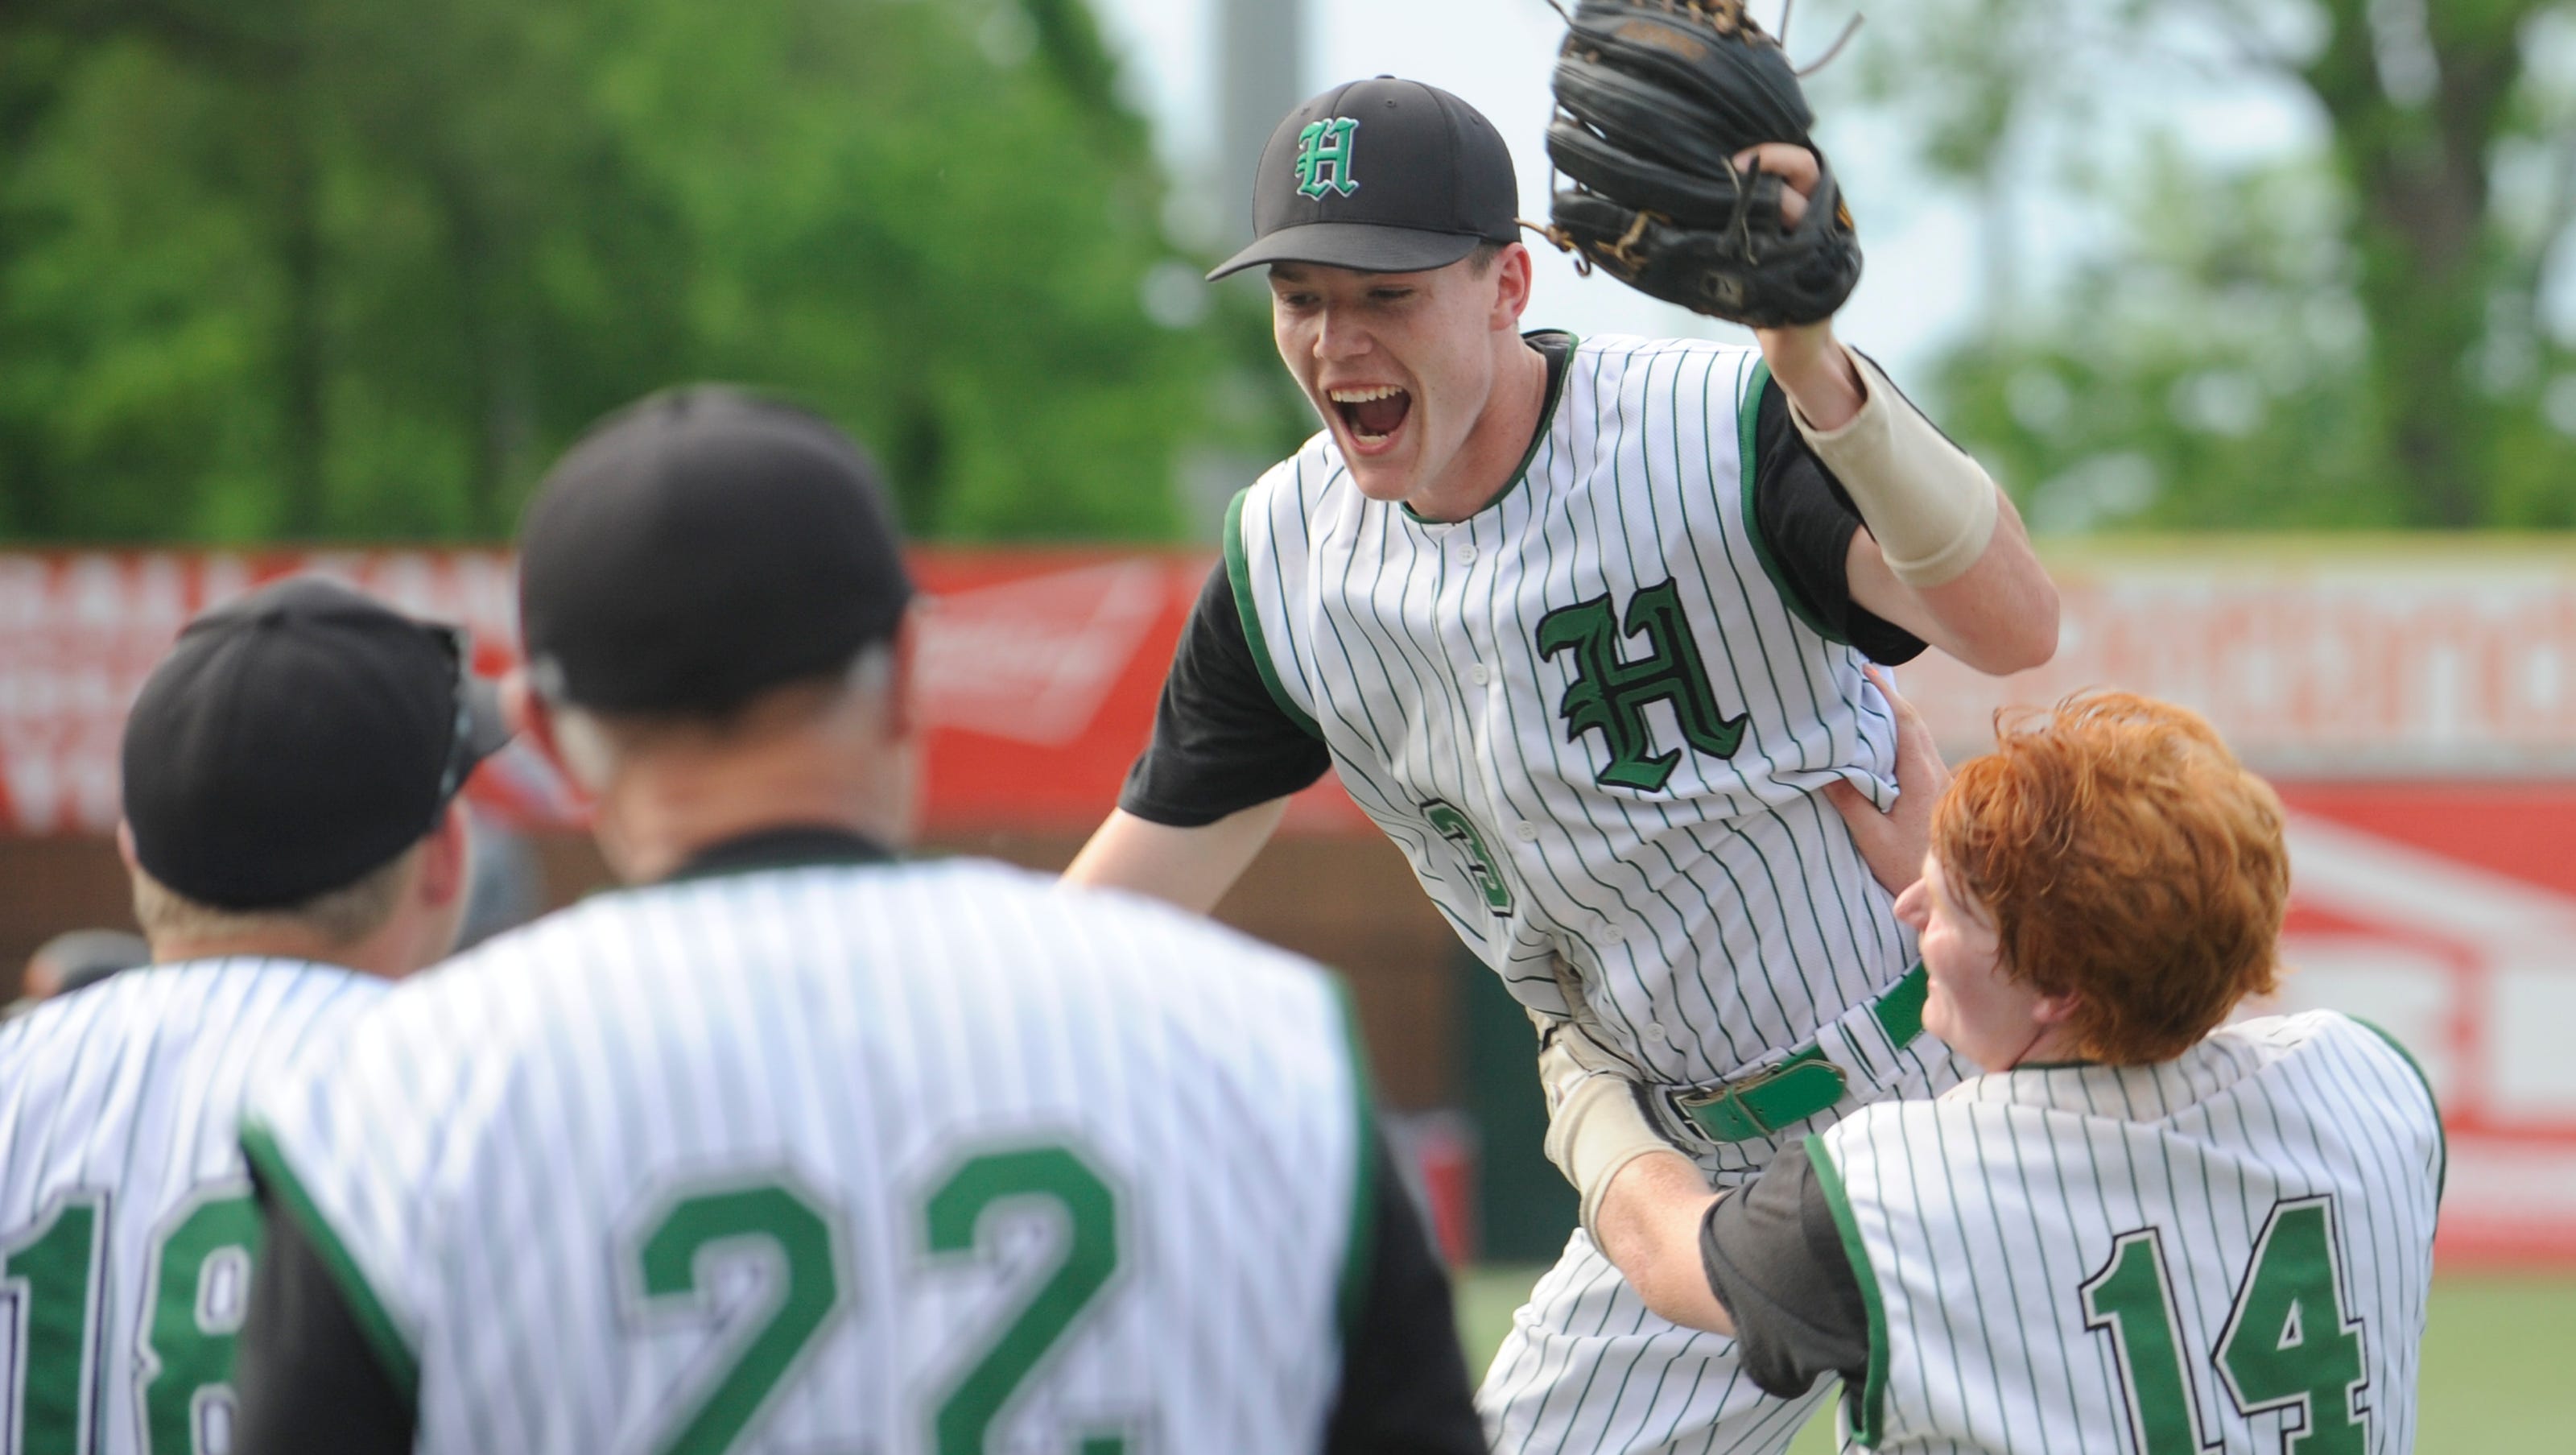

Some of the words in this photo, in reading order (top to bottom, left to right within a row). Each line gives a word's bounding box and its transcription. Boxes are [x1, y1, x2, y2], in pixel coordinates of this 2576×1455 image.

[1294, 117, 1360, 200] H
[1536, 577, 1748, 793] H
[618, 1131, 1147, 1455] 22
[2079, 1193, 2374, 1455] 14
